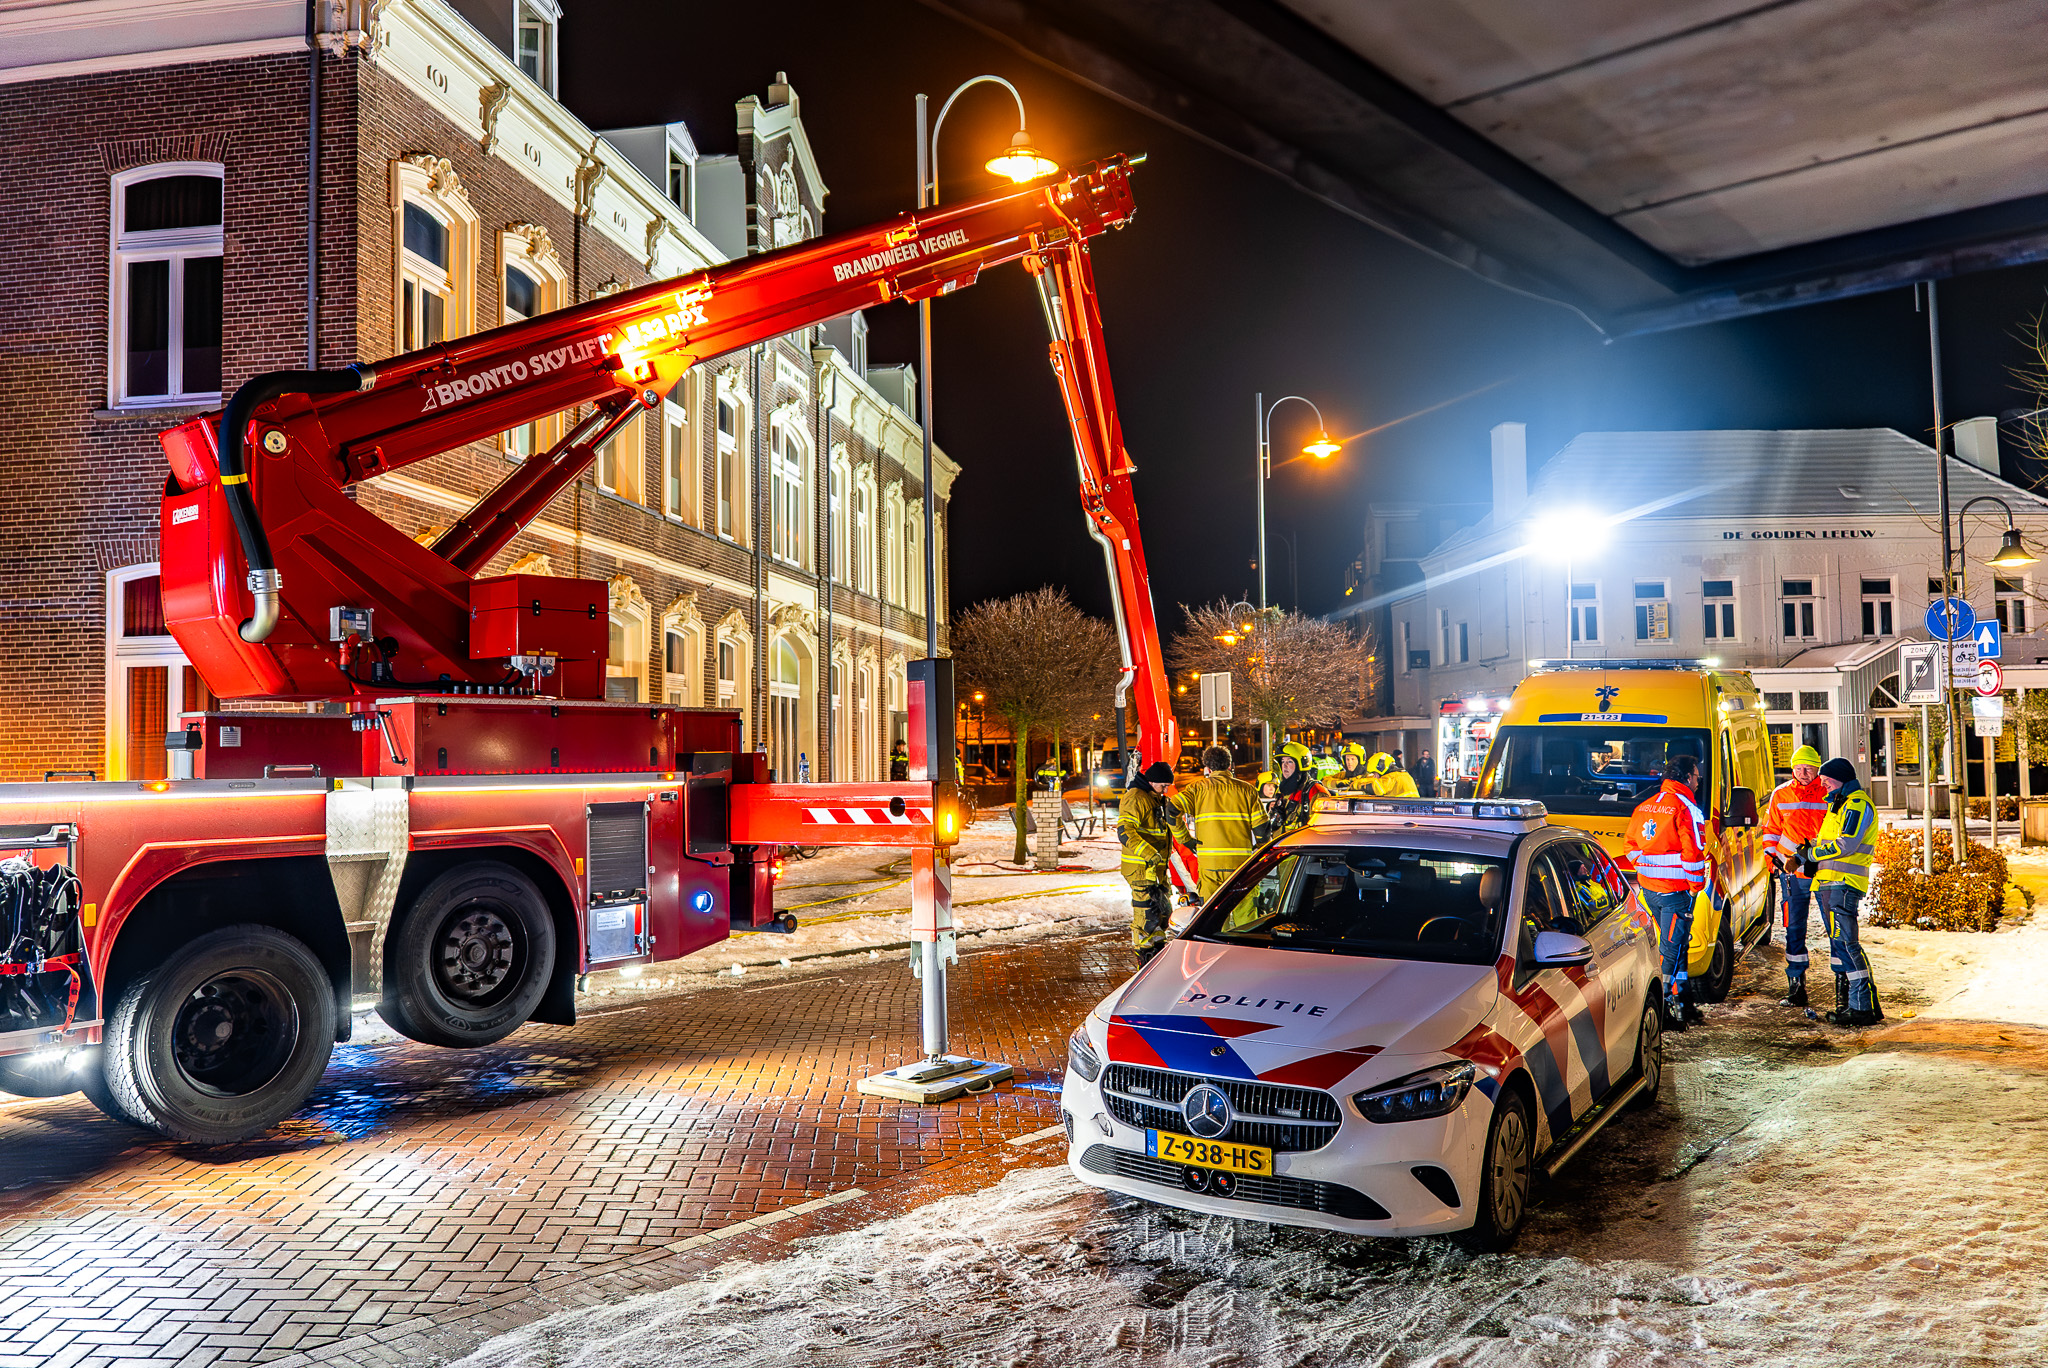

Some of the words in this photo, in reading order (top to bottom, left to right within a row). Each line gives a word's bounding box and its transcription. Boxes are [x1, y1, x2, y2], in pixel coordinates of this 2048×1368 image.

[833, 242, 919, 282] BRANDWEER
[919, 228, 969, 255] VEGHEL
[435, 360, 528, 406] BRONTO
[532, 333, 608, 376] SKYLIFT
[664, 305, 709, 334] RPX
[1723, 531, 1743, 540] DE
[1751, 530, 1816, 539] GOUDEN
[1822, 529, 1876, 539] LEEUW
[1771, 735, 1779, 757] HUUR
[1772, 757, 1779, 767] TE
[1897, 753, 1903, 762] TE
[1638, 804, 1676, 815] AMBULANCE
[1606, 971, 1634, 1013] POLITIE
[1187, 993, 1329, 1018] POLITIE
[1148, 1144, 1157, 1153] NL
[1163, 1135, 1262, 1171] Z-938-HS
